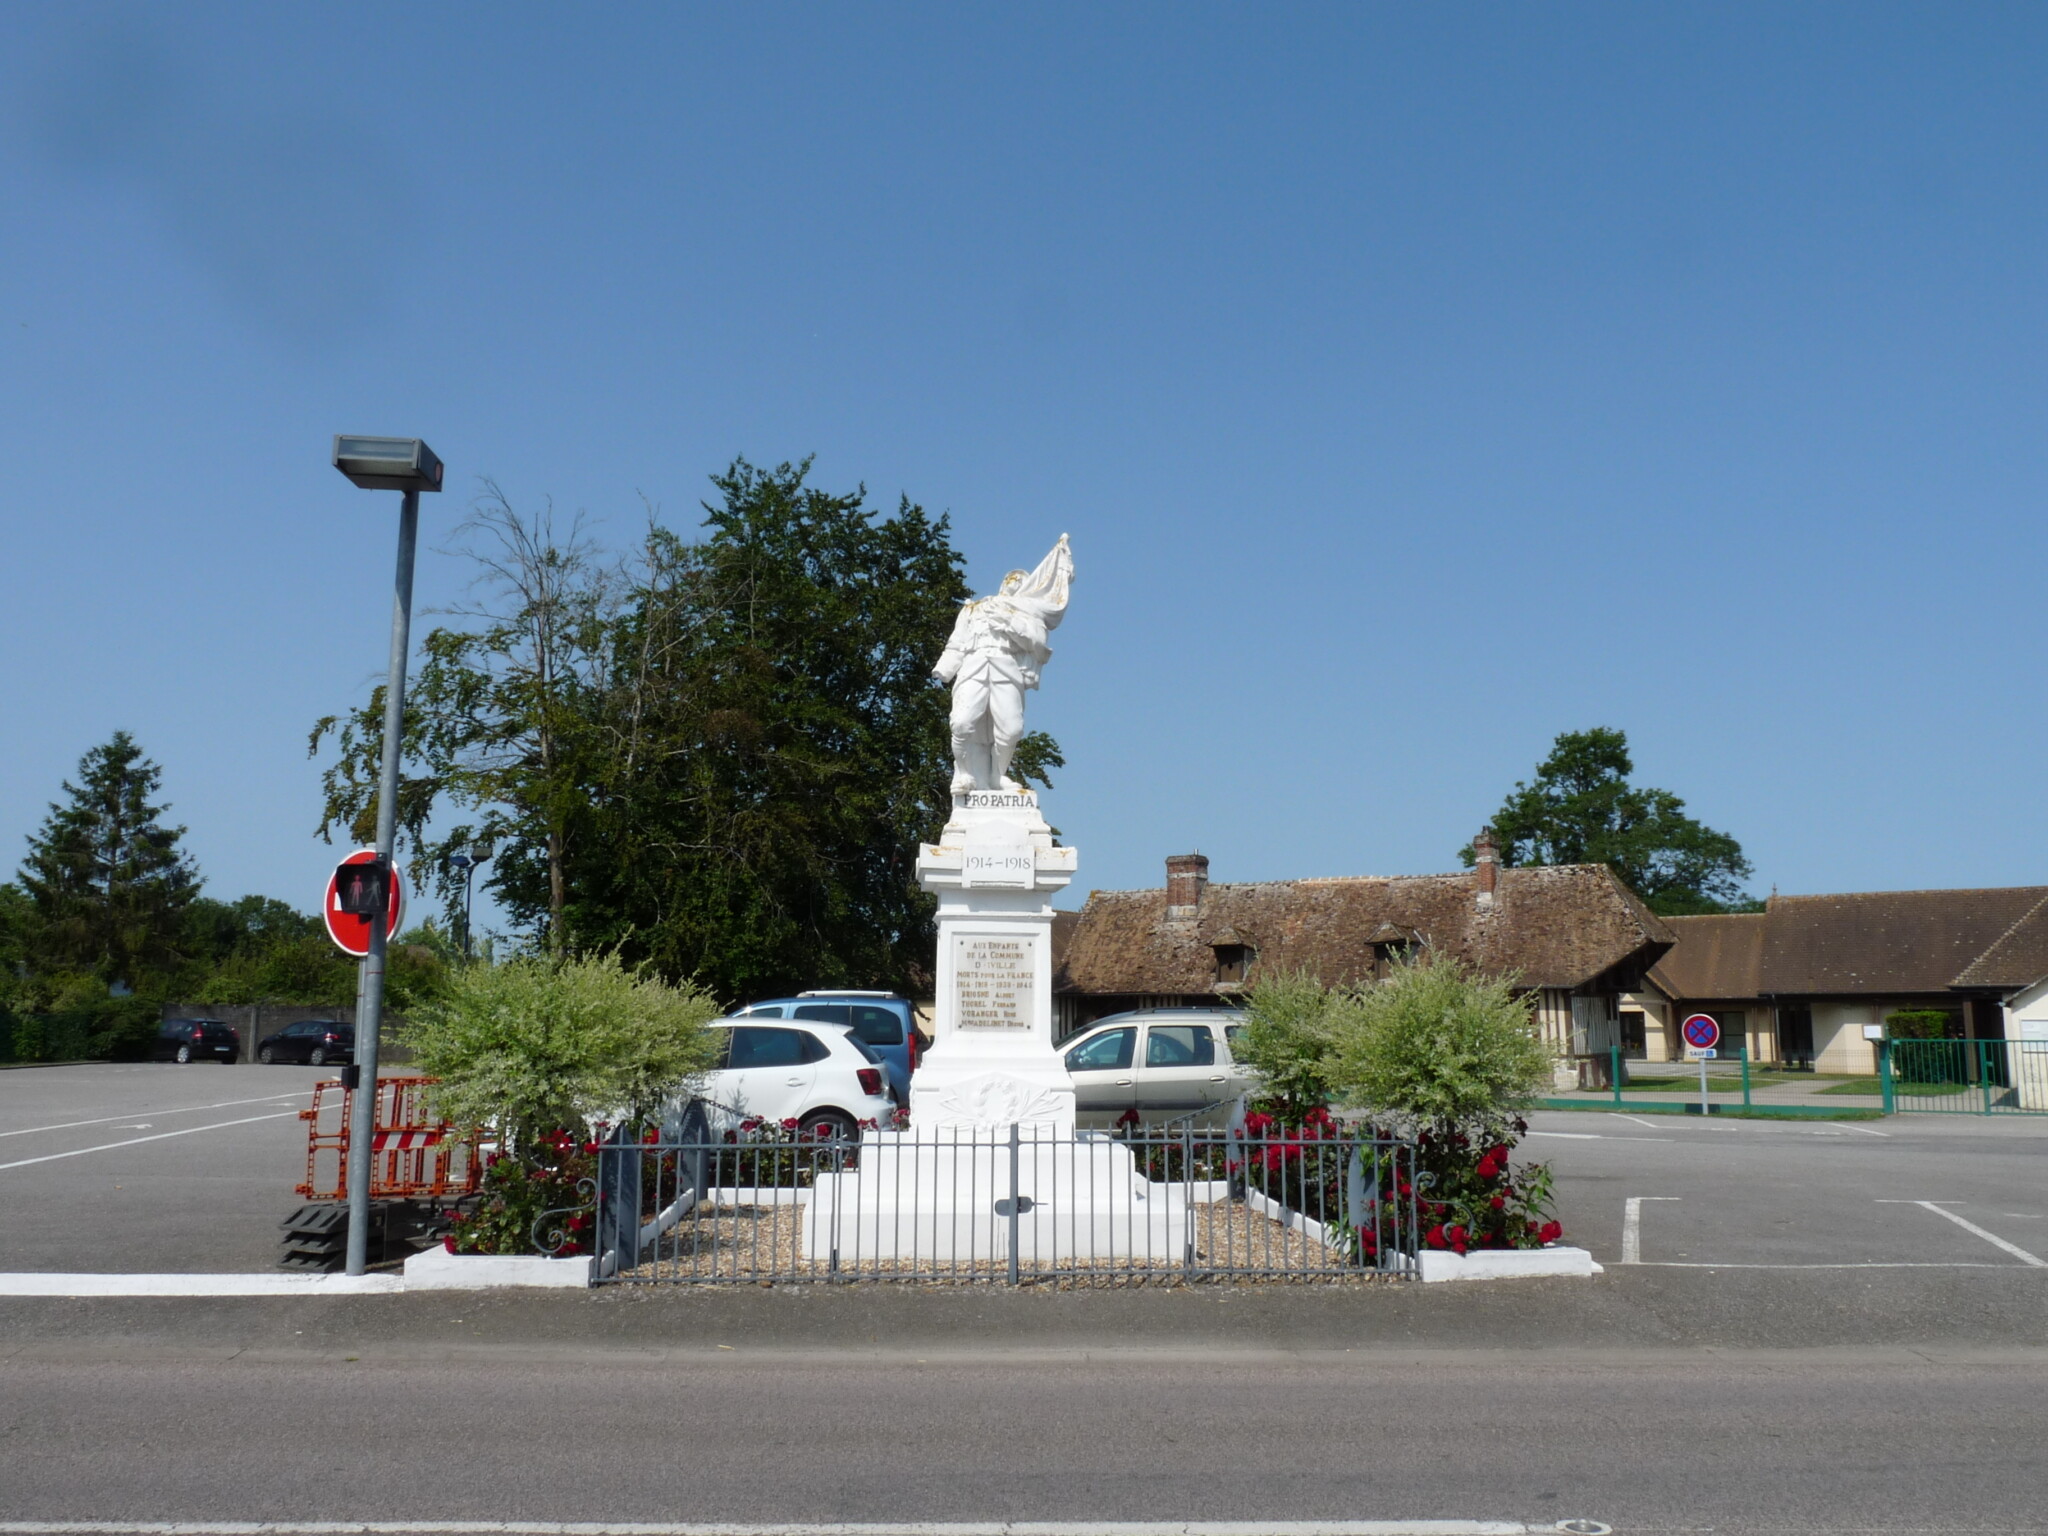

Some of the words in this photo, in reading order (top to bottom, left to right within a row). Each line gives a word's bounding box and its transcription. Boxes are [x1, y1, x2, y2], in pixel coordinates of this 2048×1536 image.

[964, 794, 988, 806] PRO
[991, 795, 1034, 807] PATRIA
[966, 857, 1031, 870] 1914-1918
[990, 951, 1024, 959] COMMUNE
